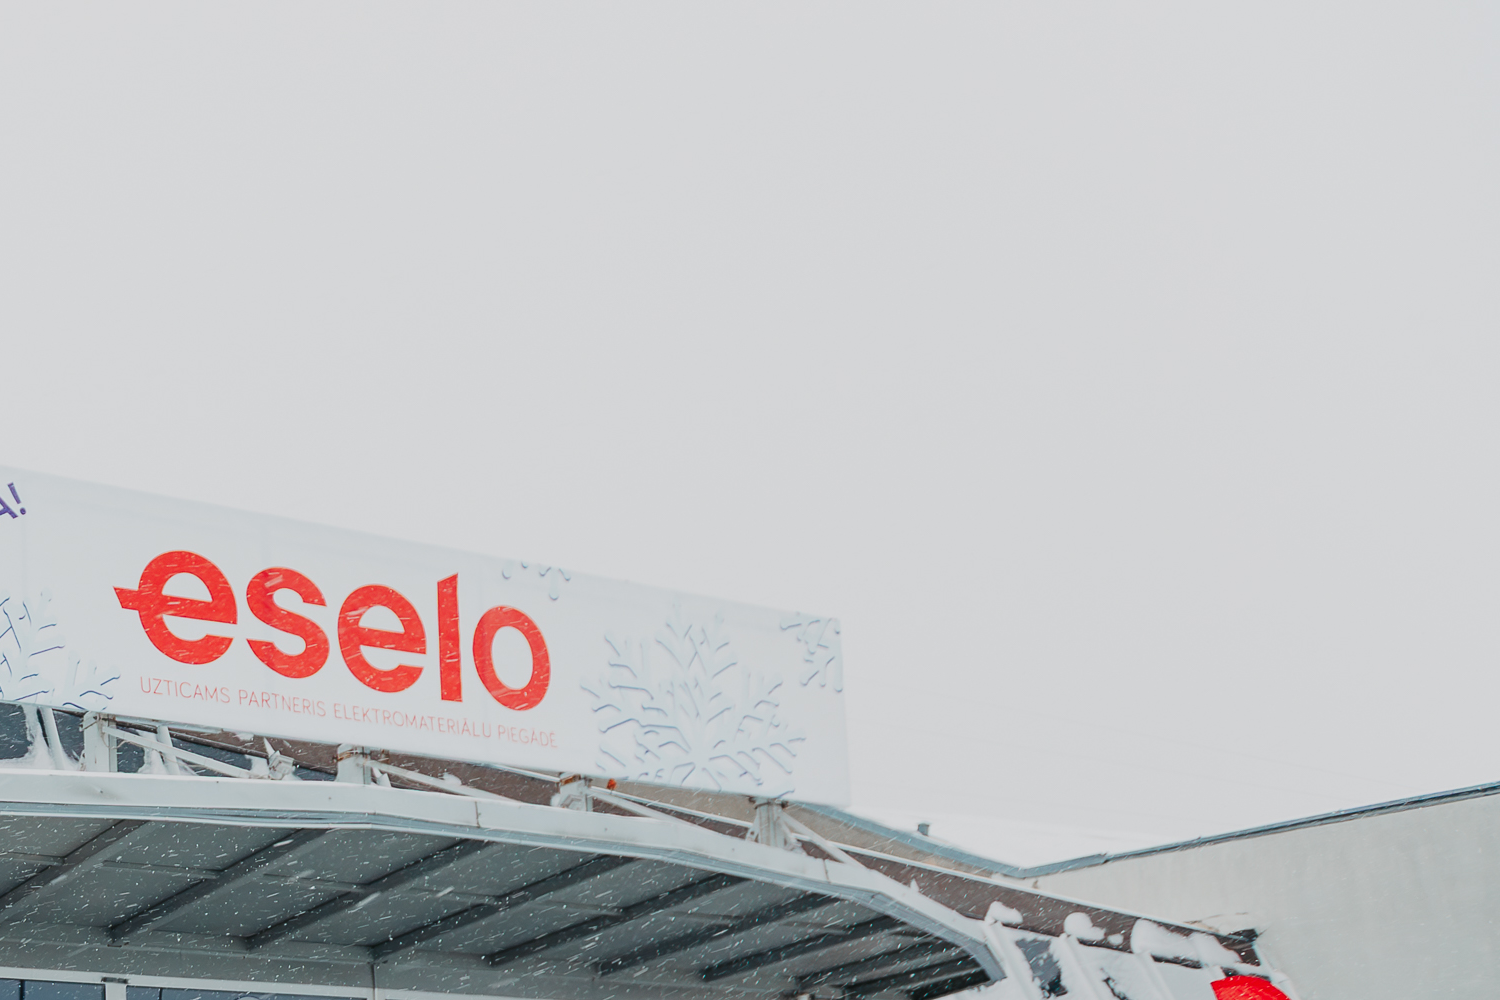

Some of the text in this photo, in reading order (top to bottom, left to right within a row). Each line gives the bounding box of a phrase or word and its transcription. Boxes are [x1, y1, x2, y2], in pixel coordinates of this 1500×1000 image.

[113, 550, 551, 711] eselo
[140, 676, 231, 704] UZTICAMS
[239, 689, 327, 718] PARTNERIS
[334, 705, 492, 738] ELEKTROMATERIĀLU
